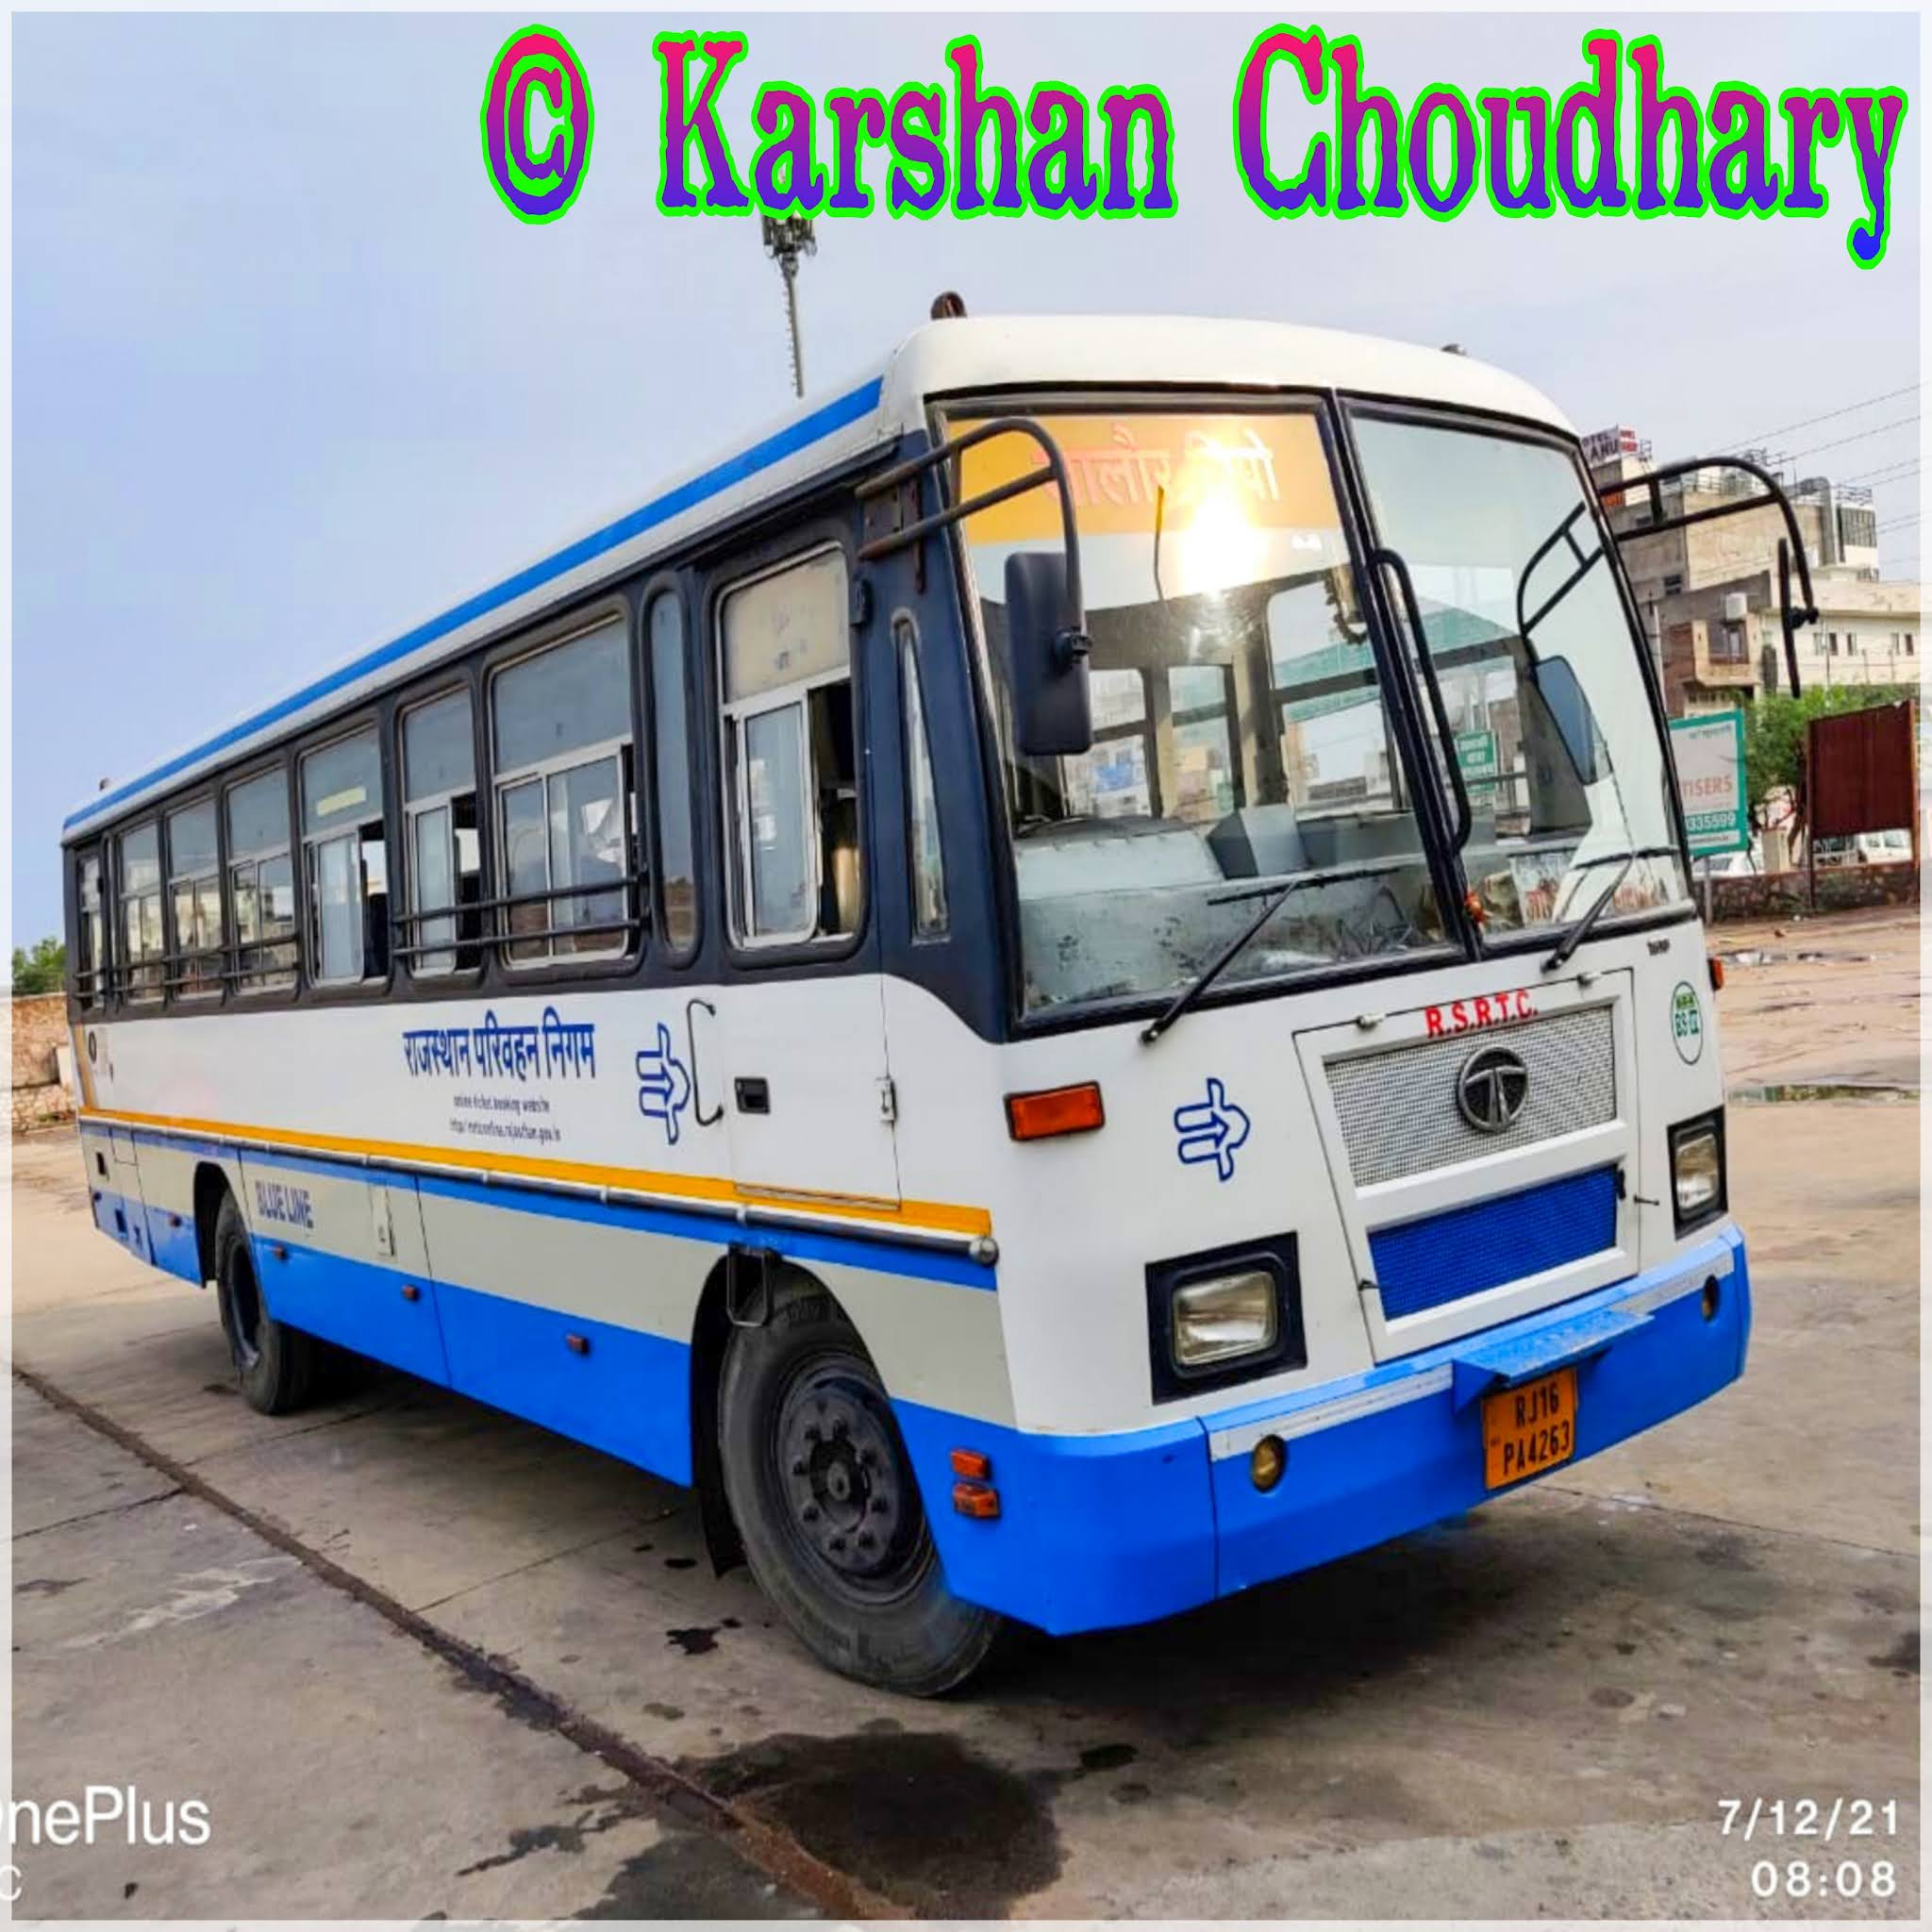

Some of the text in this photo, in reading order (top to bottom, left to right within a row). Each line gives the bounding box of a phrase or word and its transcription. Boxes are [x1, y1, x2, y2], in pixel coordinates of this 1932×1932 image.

[1425, 988, 1539, 1039] R.S.R.T.C.
[403, 1006, 595, 1082] राजस्थान परिवहन निगम
[256, 1179, 314, 1229] BLUE LINE
[1515, 1381, 1559, 1429] RJ16
[1504, 1419, 1571, 1476] PA4263
